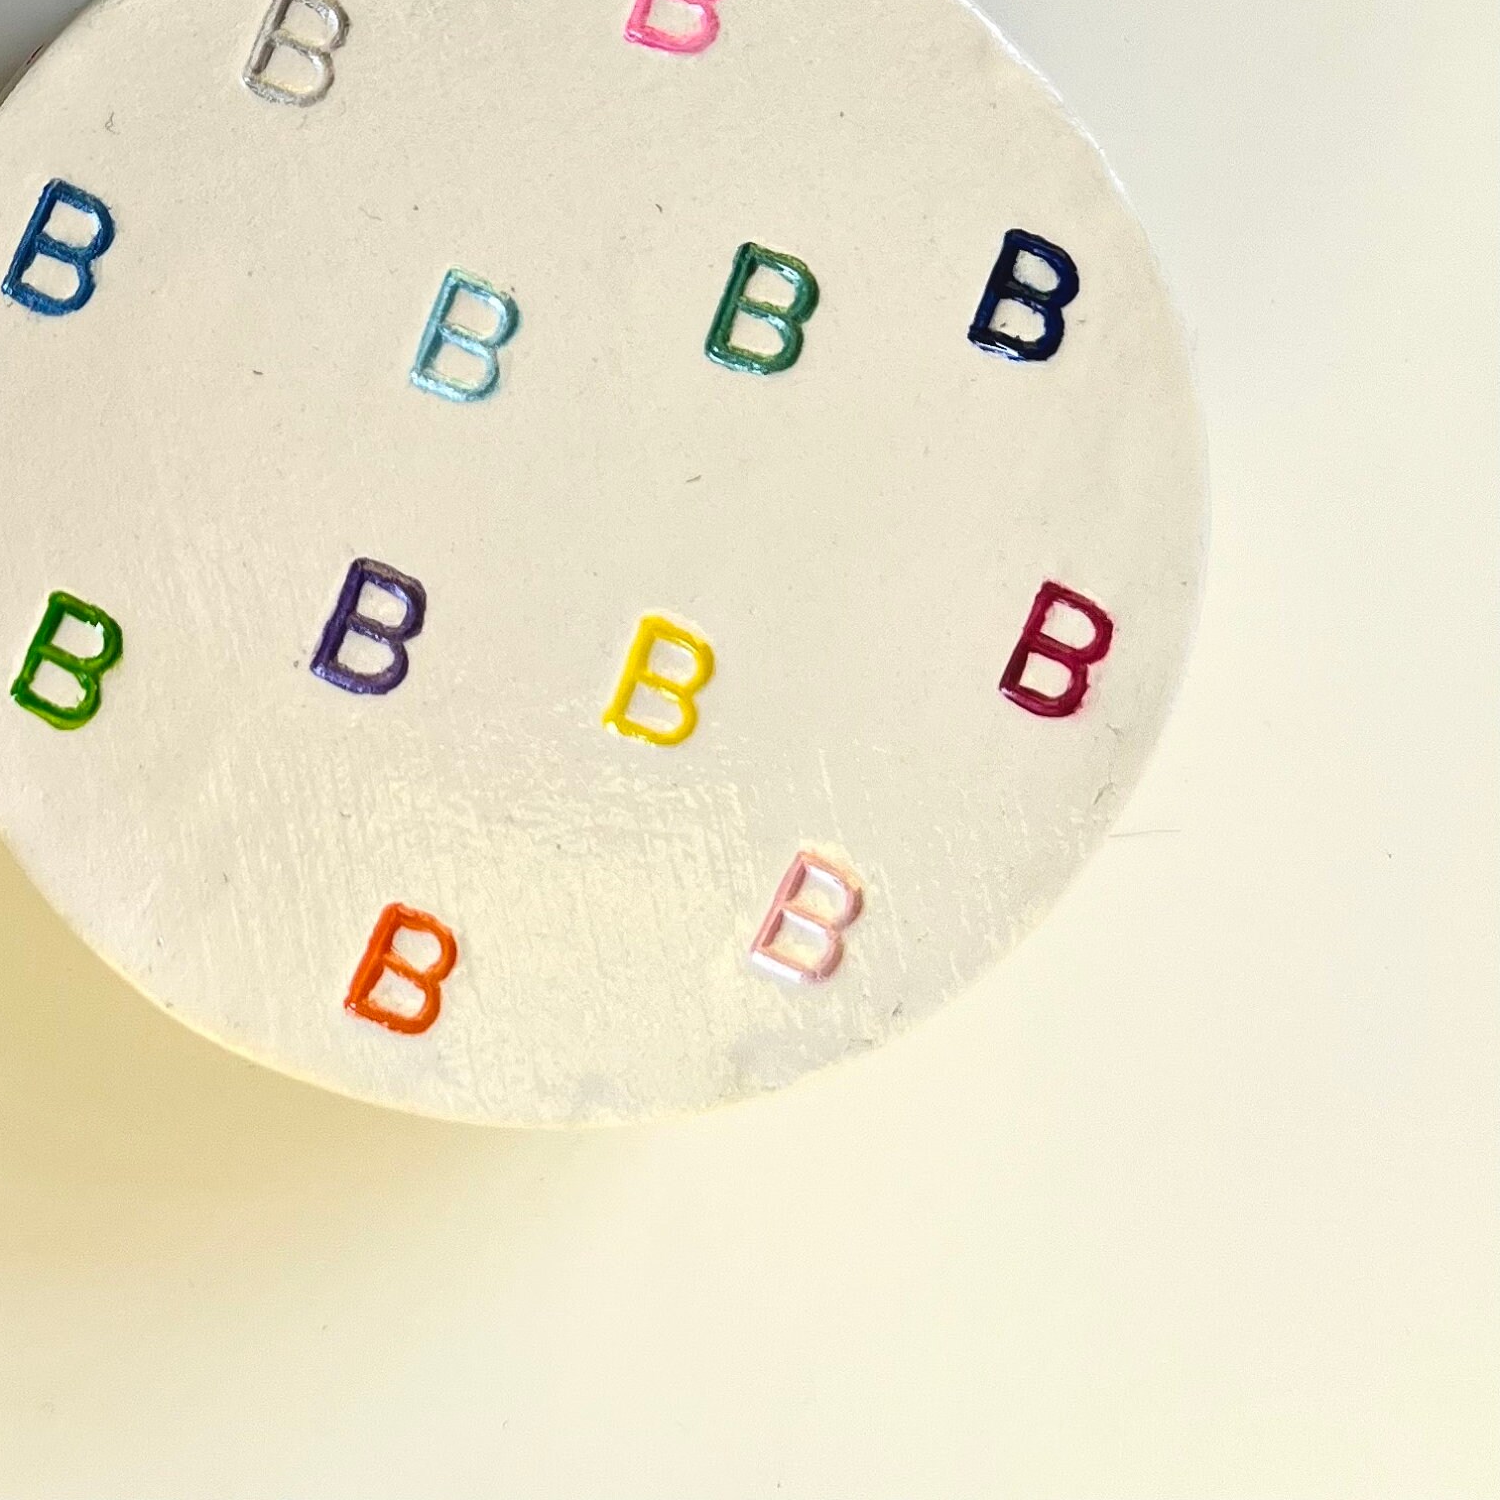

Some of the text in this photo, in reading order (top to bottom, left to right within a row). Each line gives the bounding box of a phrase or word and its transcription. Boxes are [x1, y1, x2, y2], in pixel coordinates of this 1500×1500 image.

[1, 182, 114, 316] B
[705, 244, 818, 374] B
[968, 231, 1078, 362] B
[410, 270, 521, 402] B
[11, 592, 122, 730] B
[310, 560, 424, 694] B
[602, 616, 714, 745] B
[1000, 582, 1113, 718] B
[344, 905, 457, 1034] B
[750, 852, 863, 985] B
